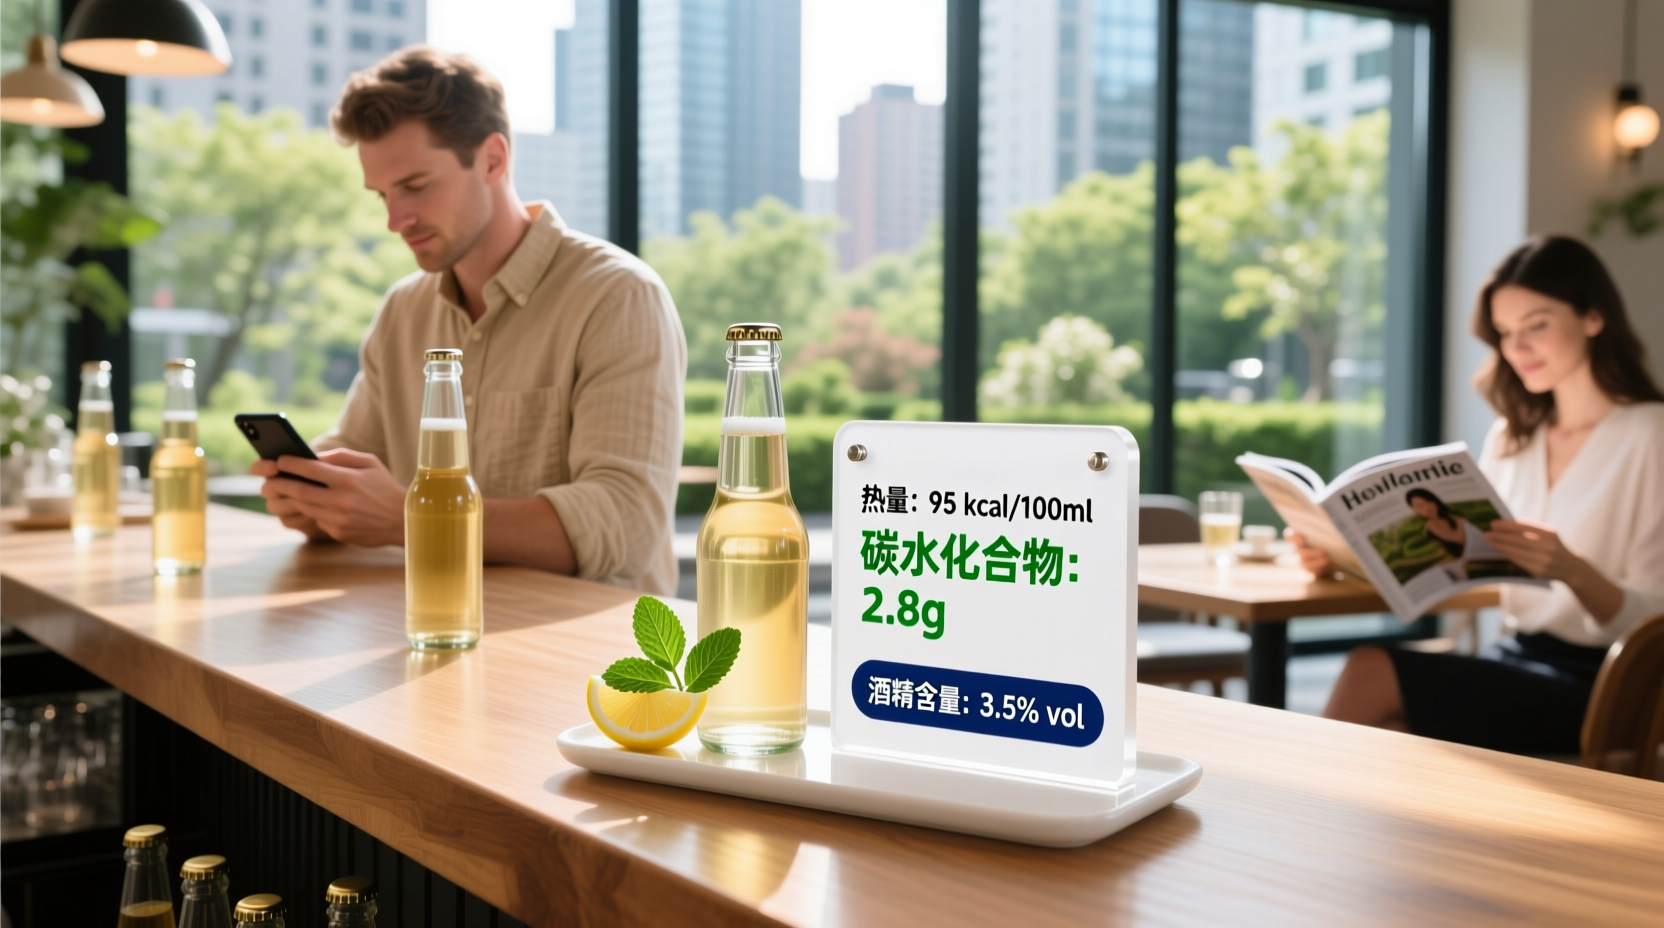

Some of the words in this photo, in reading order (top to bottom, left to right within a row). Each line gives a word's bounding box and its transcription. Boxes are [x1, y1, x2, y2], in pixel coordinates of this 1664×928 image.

[861, 483, 918, 514] 热量：
[928, 490, 957, 515] 95
[964, 491, 1093, 524] kcal/100ml
[860, 528, 1078, 587] 碳水化合物：
[861, 586, 946, 641] 2.8g
[868, 675, 969, 716] 酒精含量：
[979, 692, 1040, 724] 3.5%
[1046, 702, 1085, 730] vol
